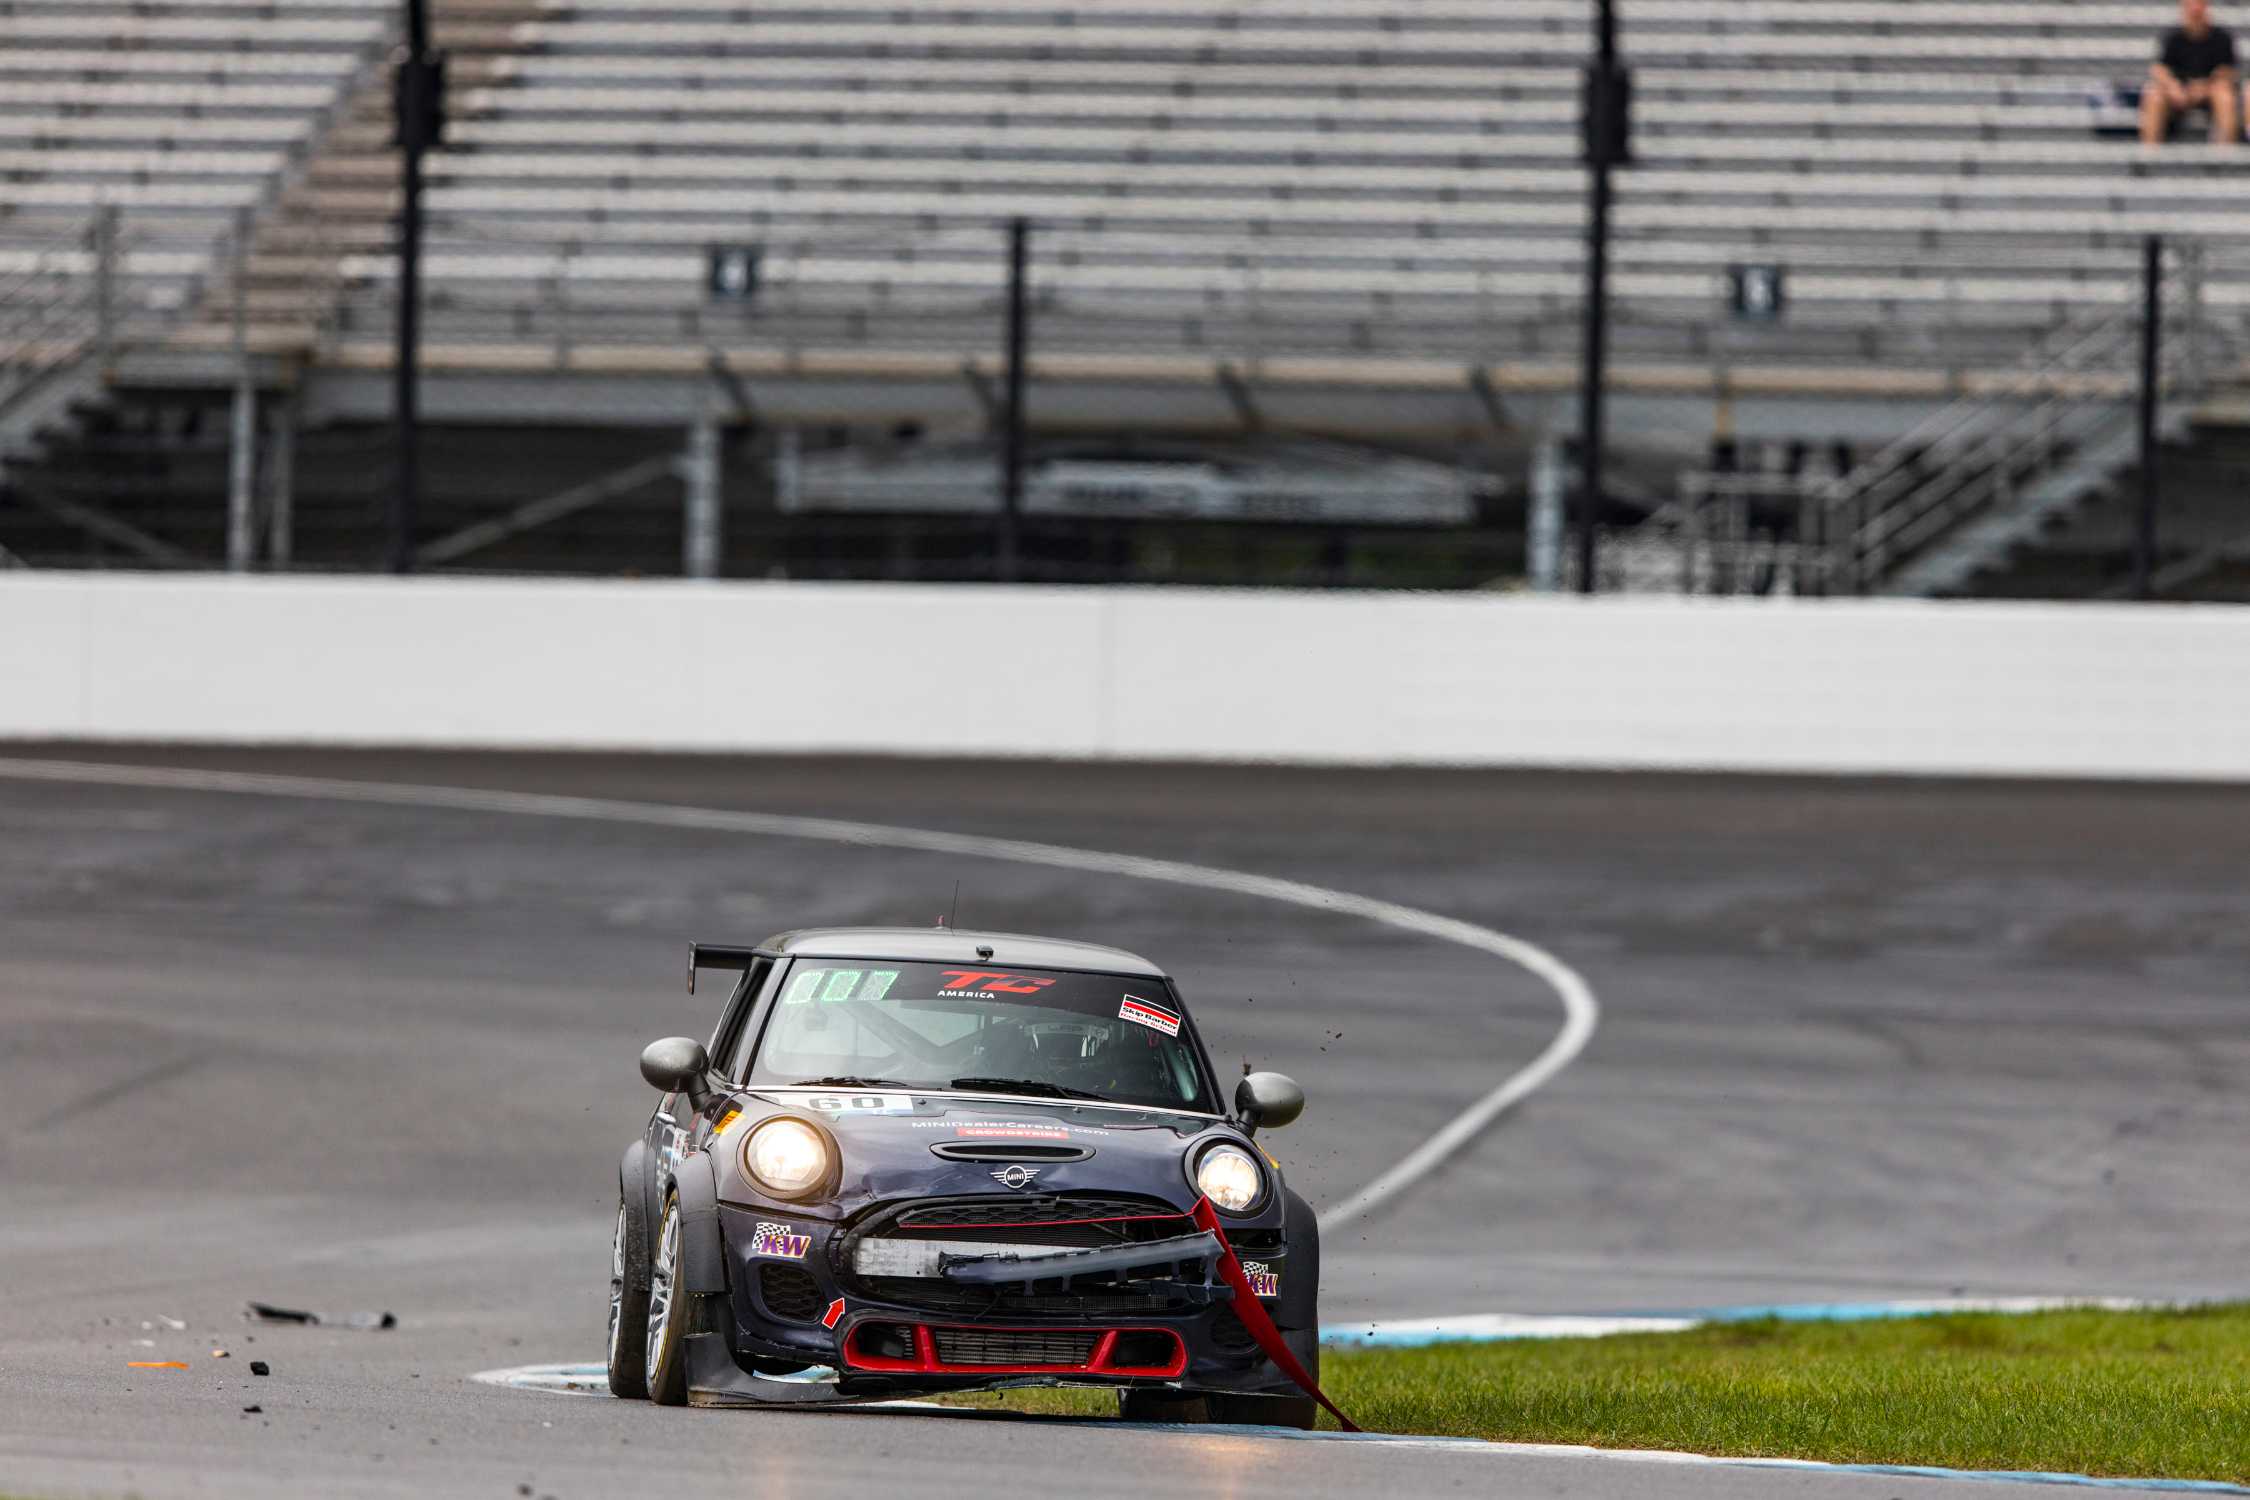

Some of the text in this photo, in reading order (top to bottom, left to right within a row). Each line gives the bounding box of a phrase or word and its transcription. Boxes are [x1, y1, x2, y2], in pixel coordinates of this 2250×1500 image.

[941, 970, 1056, 993] TC
[937, 990, 995, 999] AMERICA
[1122, 1007, 1177, 1030] Skip Barber
[809, 1097, 884, 1109] 60
[1007, 1172, 1025, 1181] MINI
[759, 1234, 811, 1257] KW
